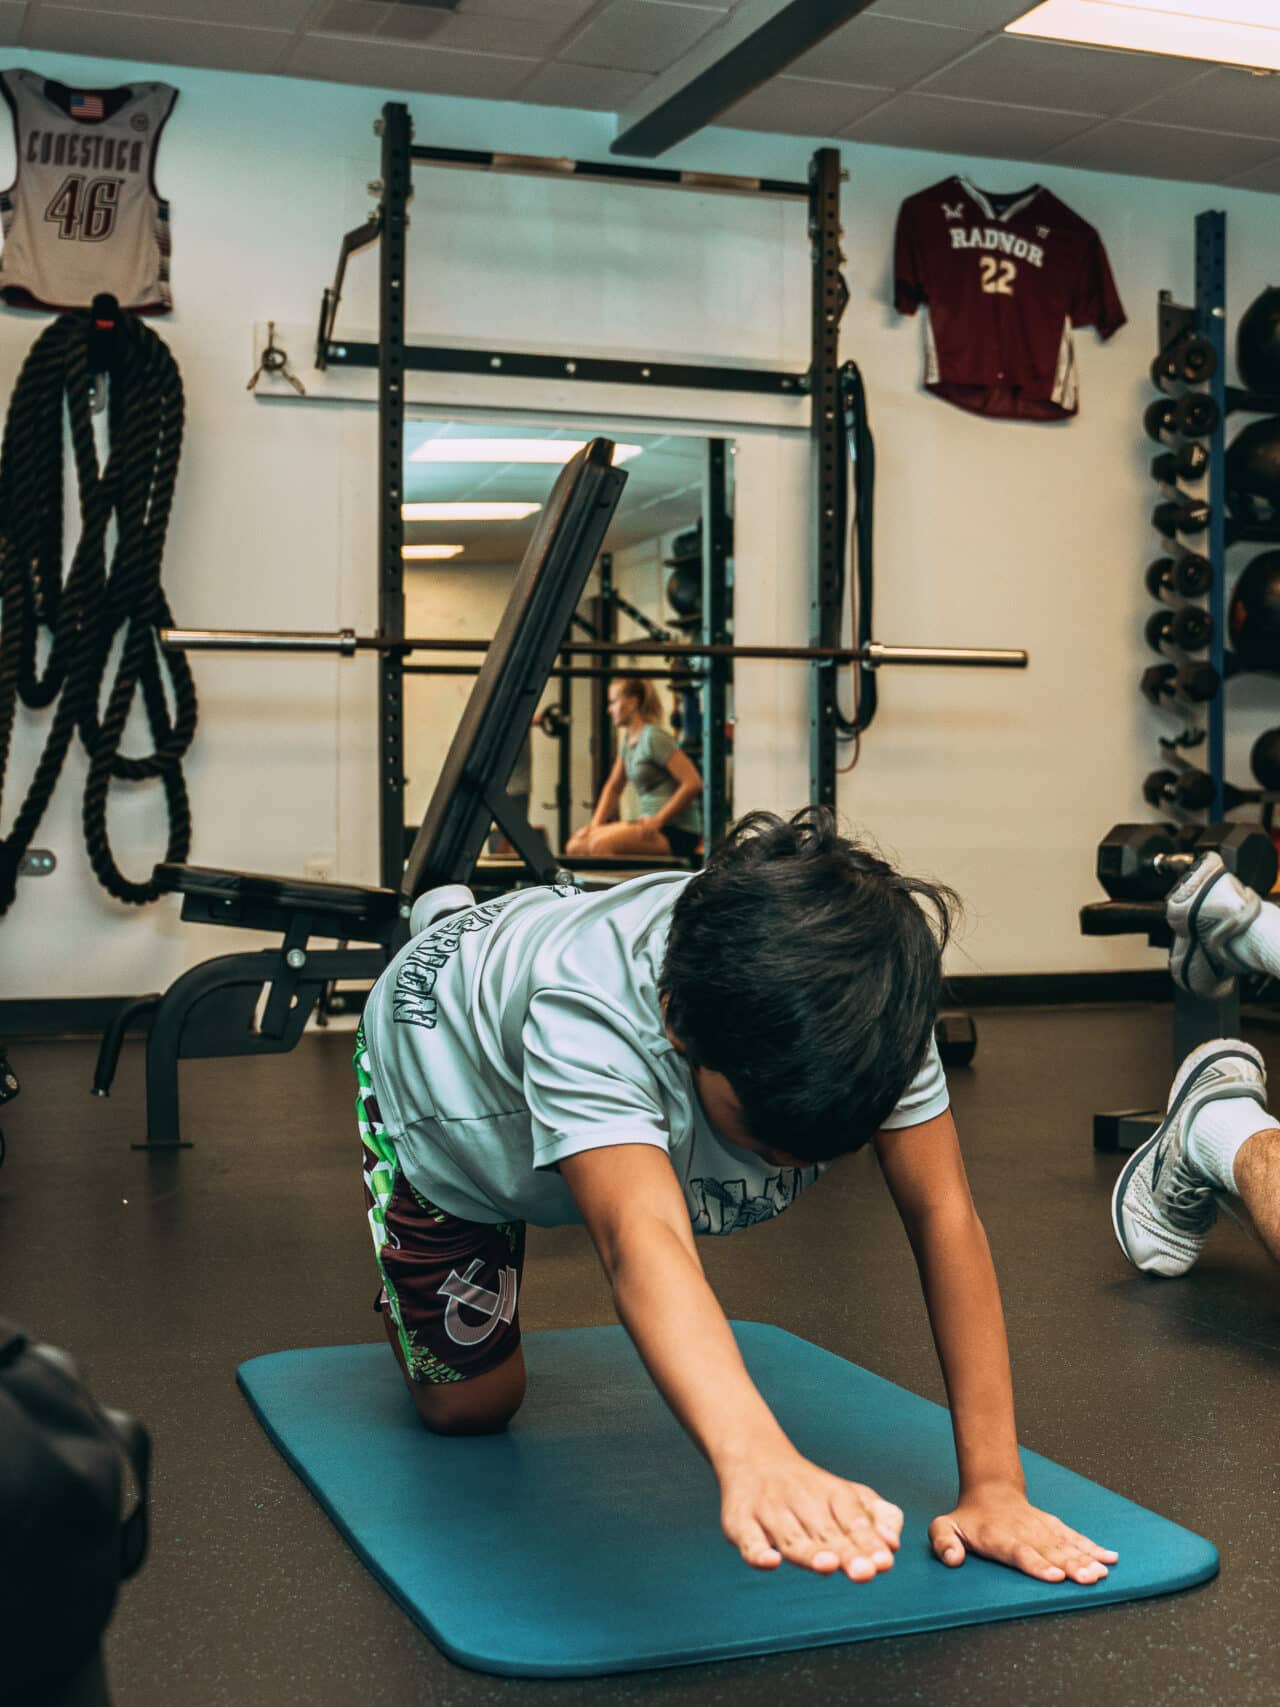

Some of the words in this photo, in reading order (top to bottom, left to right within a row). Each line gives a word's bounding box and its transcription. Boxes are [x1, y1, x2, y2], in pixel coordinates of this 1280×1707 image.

[44, 172, 126, 243] 46
[950, 227, 1045, 268] RADNOR
[979, 255, 1018, 296] 22
